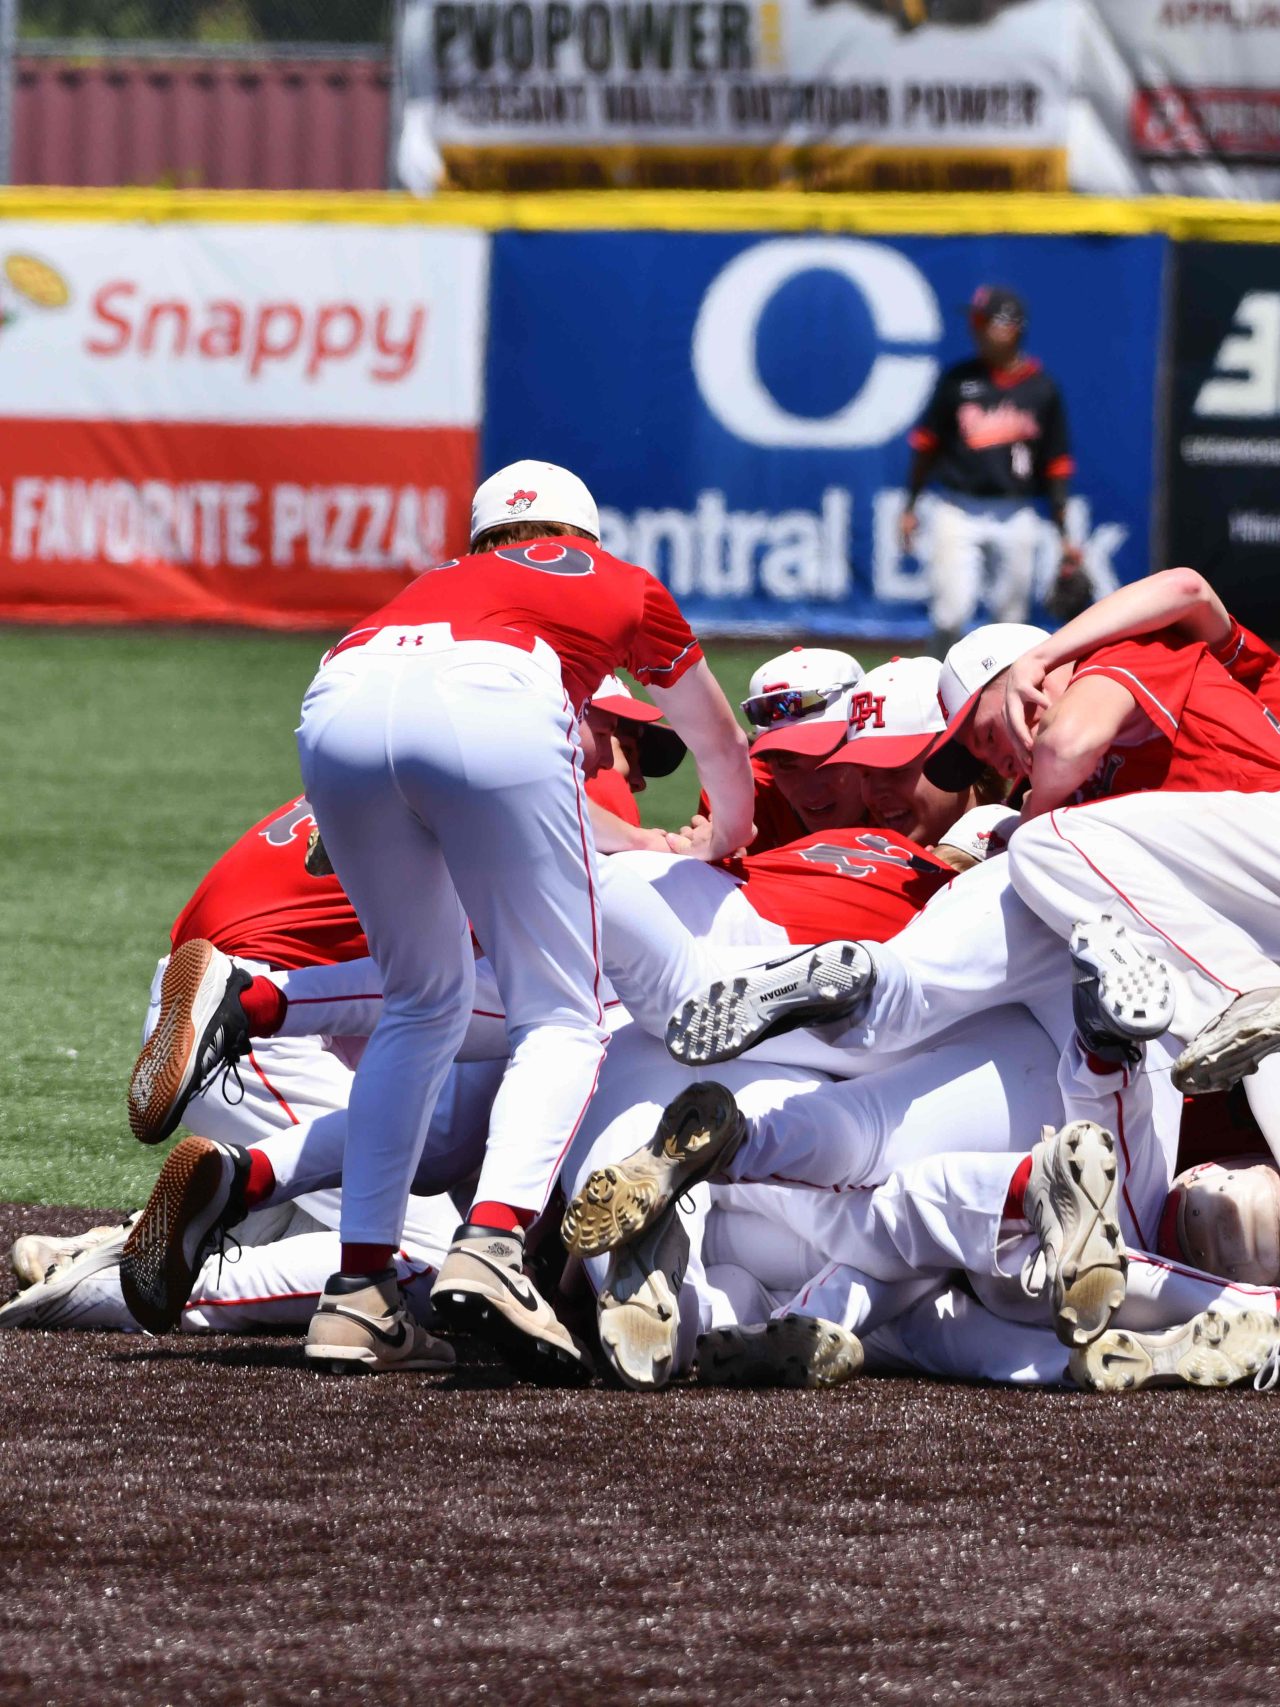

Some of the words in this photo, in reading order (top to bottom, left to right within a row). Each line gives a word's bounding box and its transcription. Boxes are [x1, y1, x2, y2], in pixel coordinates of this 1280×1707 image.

[84, 280, 428, 382] Snappy
[10, 476, 261, 568] FAVORITE
[270, 484, 447, 571] PIZZA!
[598, 484, 851, 599] entral
[759, 981, 800, 1003] JORDAN
